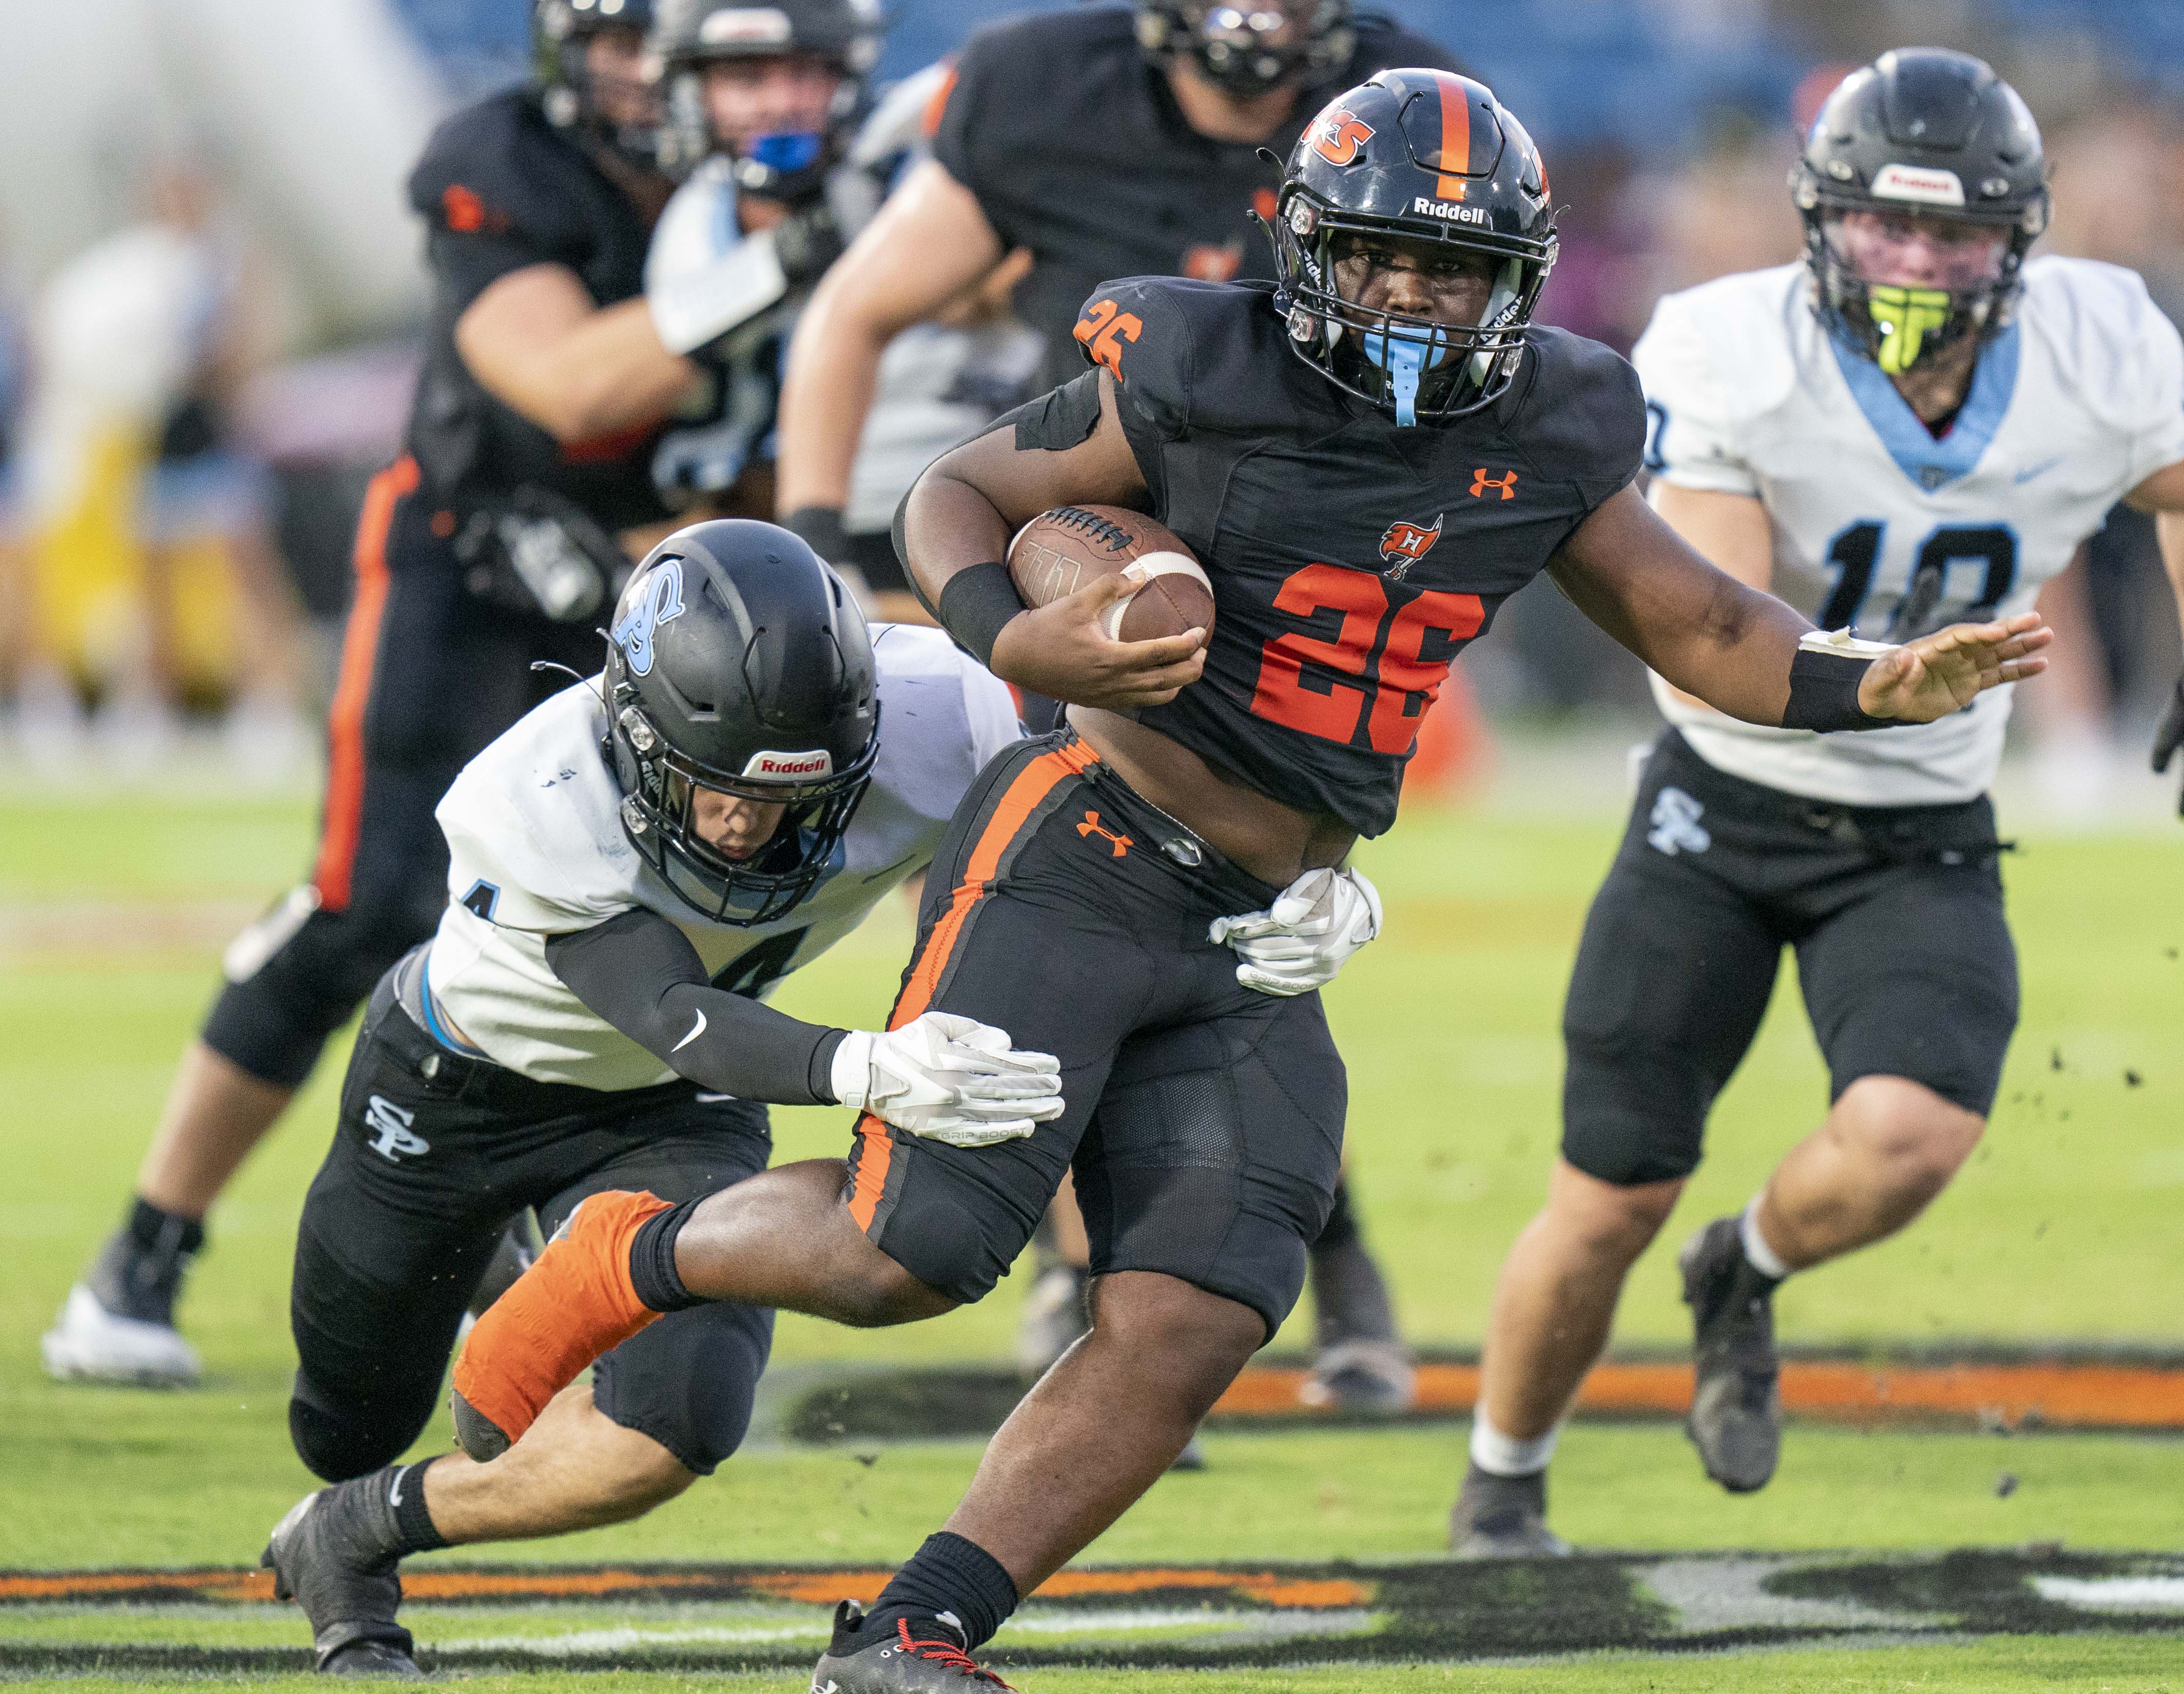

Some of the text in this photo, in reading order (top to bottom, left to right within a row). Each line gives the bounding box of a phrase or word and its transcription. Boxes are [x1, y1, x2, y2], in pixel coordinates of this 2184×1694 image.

[1414, 197, 1483, 224] Riddell
[1398, 530, 1425, 553] H
[1250, 563, 1485, 754] 26
[761, 759, 826, 773] Riddell
[978, 1127, 1027, 1139] BOOST
